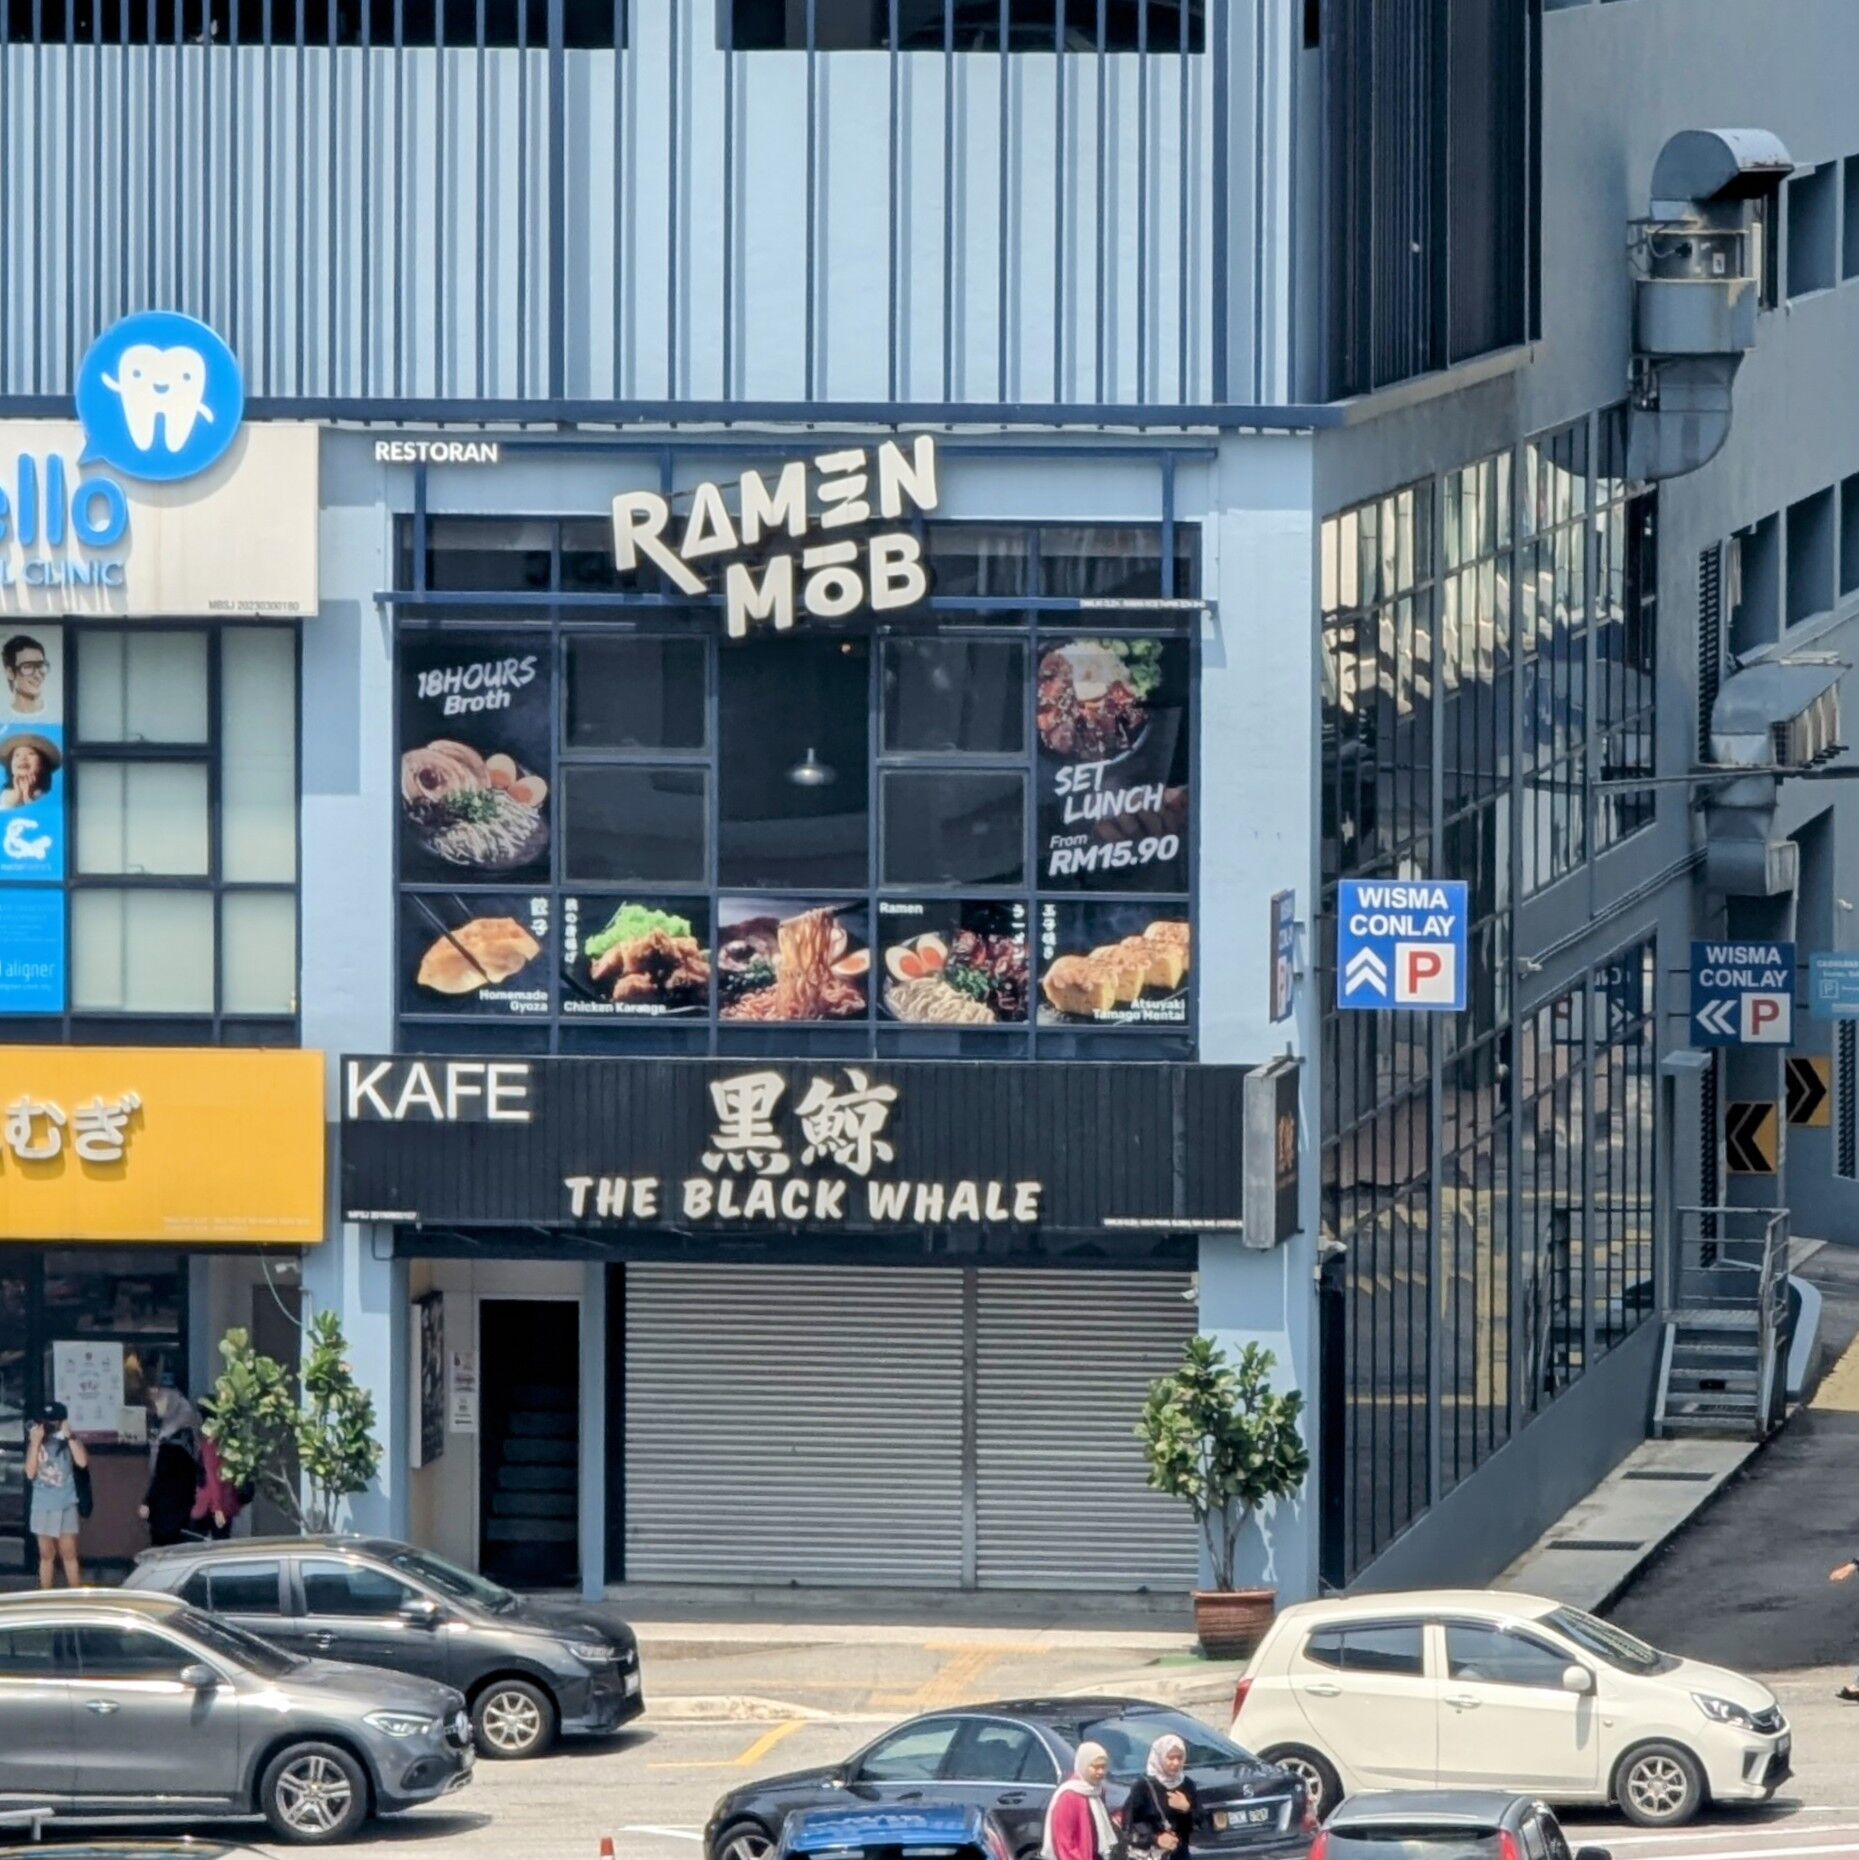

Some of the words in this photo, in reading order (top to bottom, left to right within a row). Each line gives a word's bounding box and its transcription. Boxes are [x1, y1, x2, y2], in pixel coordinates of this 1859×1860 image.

[375, 441, 498, 463] RESTORAN
[0, 453, 128, 546] llo
[612, 435, 938, 595] RAMEN
[24, 559, 123, 586] CLINIC
[417, 655, 538, 699] 18HOURS
[443, 689, 511, 716] Broth
[1054, 759, 1112, 797] SET
[1063, 782, 1165, 825] LUNCH
[1049, 834, 1088, 850] From
[1049, 834, 1180, 877] RM15.90
[879, 902, 924, 915] Ramen
[1357, 887, 1449, 910] WISMA
[1349, 914, 1456, 937] CONLAY
[1706, 946, 1782, 965] WISMA
[6, 959, 55, 982] aligner
[1408, 950, 1442, 994] P
[1699, 969, 1788, 988] CONLAY
[479, 989, 548, 1001] Homemade
[1130, 999, 1185, 1011] Atsuyaki
[510, 1001, 548, 1014] Gyoza
[563, 1001, 614, 1013] Chicken
[1092, 1008, 1142, 1021] Tamago
[1752, 999, 1780, 1036] P
[346, 1061, 532, 1121] KAFE
[564, 1176, 660, 1218] THE
[682, 1176, 849, 1222] BLACK
[868, 1179, 1044, 1224] WHALE
